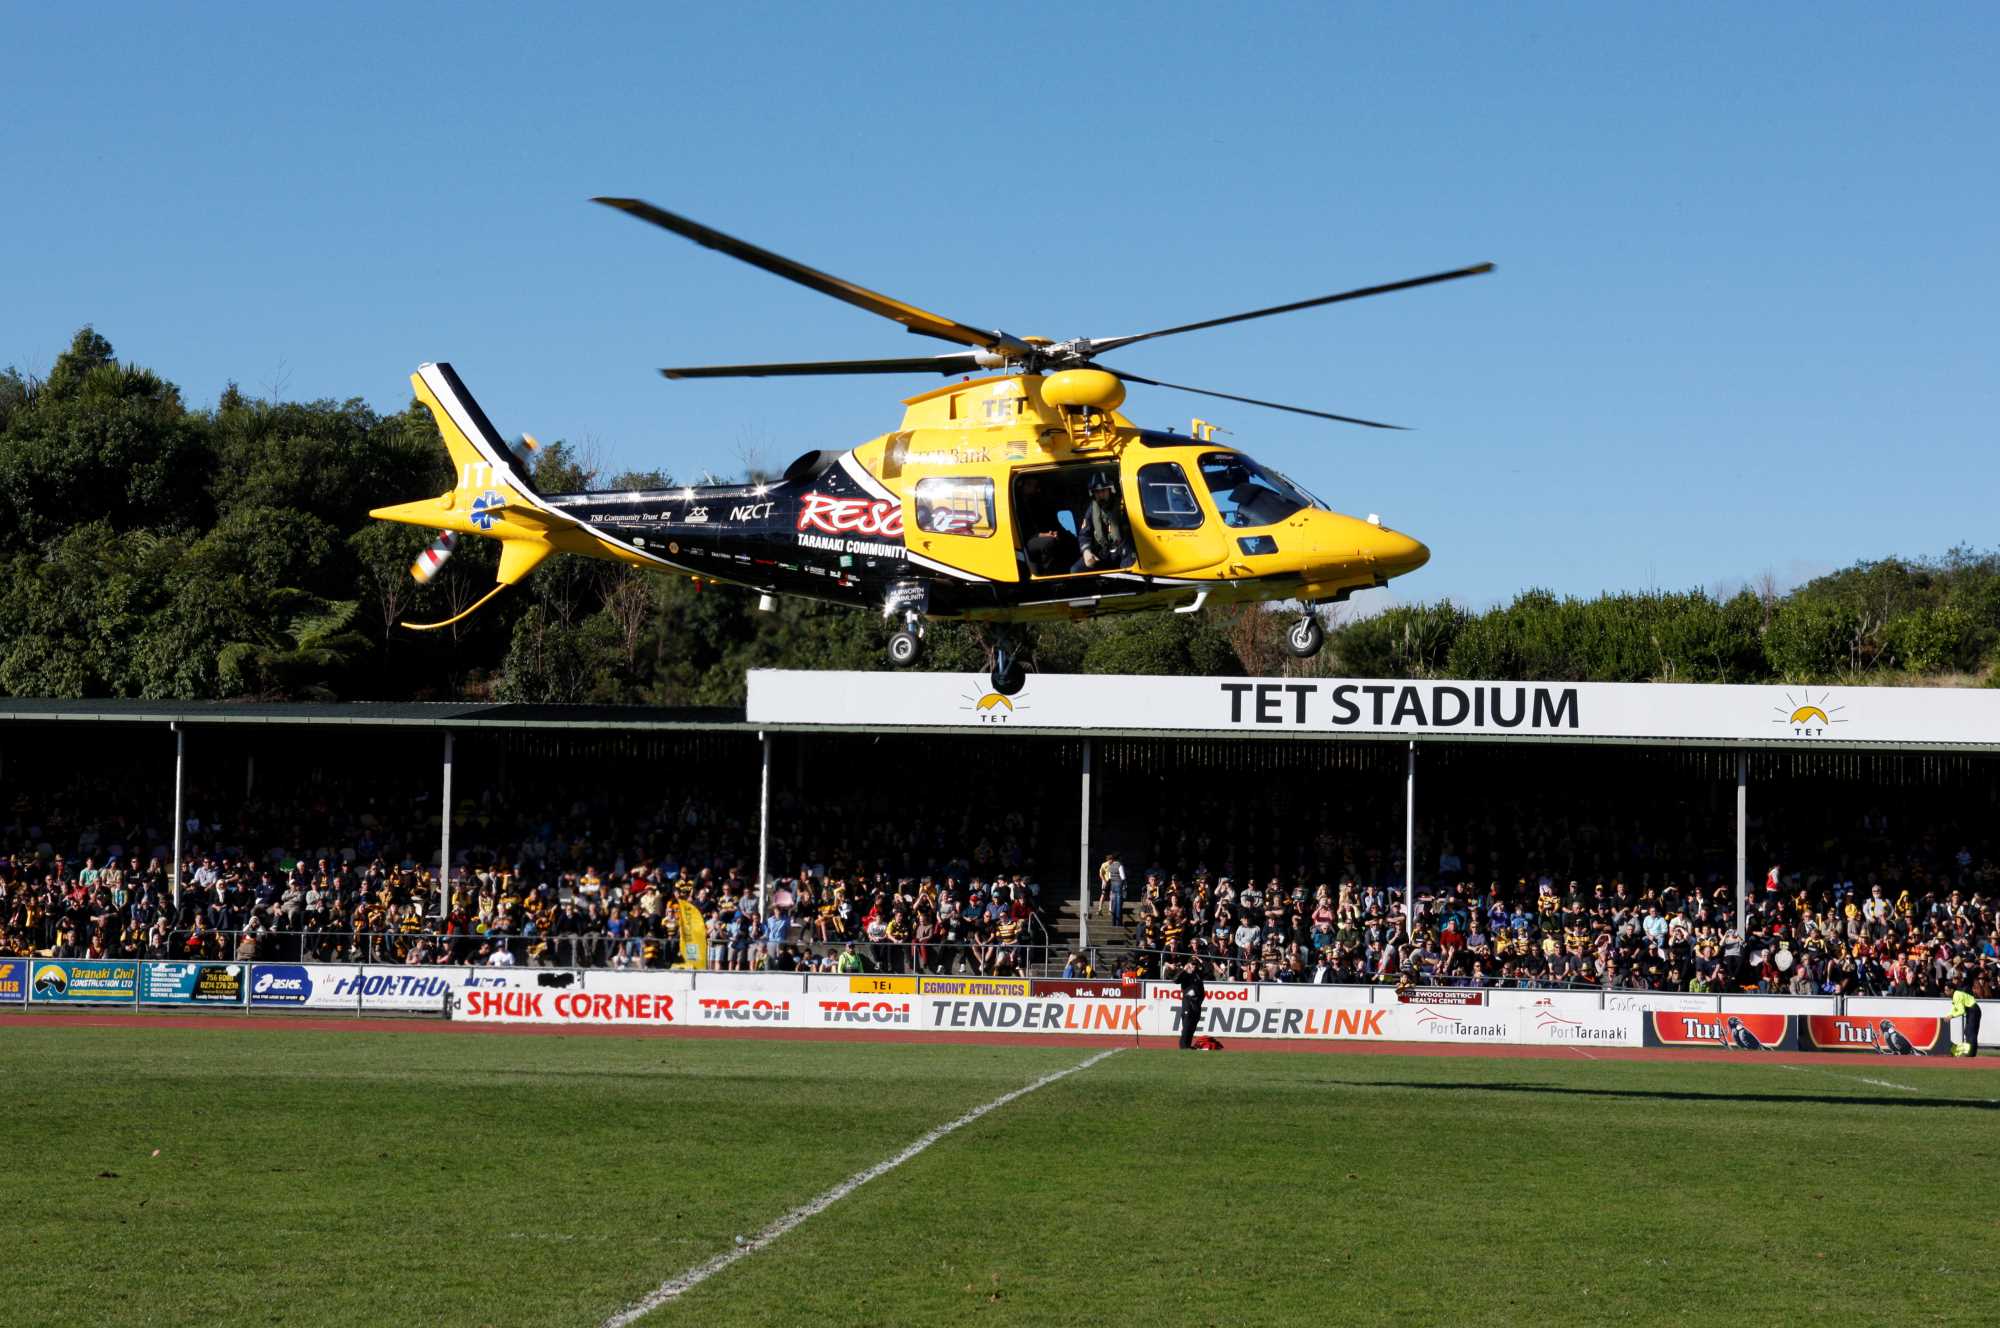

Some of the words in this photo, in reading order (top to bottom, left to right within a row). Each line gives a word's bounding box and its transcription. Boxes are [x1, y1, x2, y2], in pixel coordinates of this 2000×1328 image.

[590, 514, 603, 523] TSB
[603, 513, 641, 523] Community
[642, 512, 659, 521] Trust
[730, 501, 775, 522] NZCT
[798, 533, 844, 551] TARANAKI
[846, 540, 907, 559] COMMUNITY
[1221, 683, 1318, 724] TET
[1331, 684, 1580, 728] STADIUM
[981, 715, 1008, 723] TET
[1794, 728, 1823, 736] TET
[71, 967, 110, 979] Taranaki
[114, 968, 135, 979] Civil
[70, 979, 119, 988] CONSTRUCTION
[121, 980, 134, 988] LTD
[272, 978, 302, 990] asics
[923, 981, 965, 993] EGMONT
[968, 983, 1025, 995] ATHLETICS
[1153, 987, 1248, 1001] Ingwood
[1409, 997, 1438, 1005] HEALTH
[467, 991, 543, 1018] SHUK
[554, 993, 674, 1022] CORNER
[932, 1000, 1148, 1031] TENDERLINK
[1682, 1018, 1722, 1040] Tui
[1835, 1022, 1873, 1043] Tui
